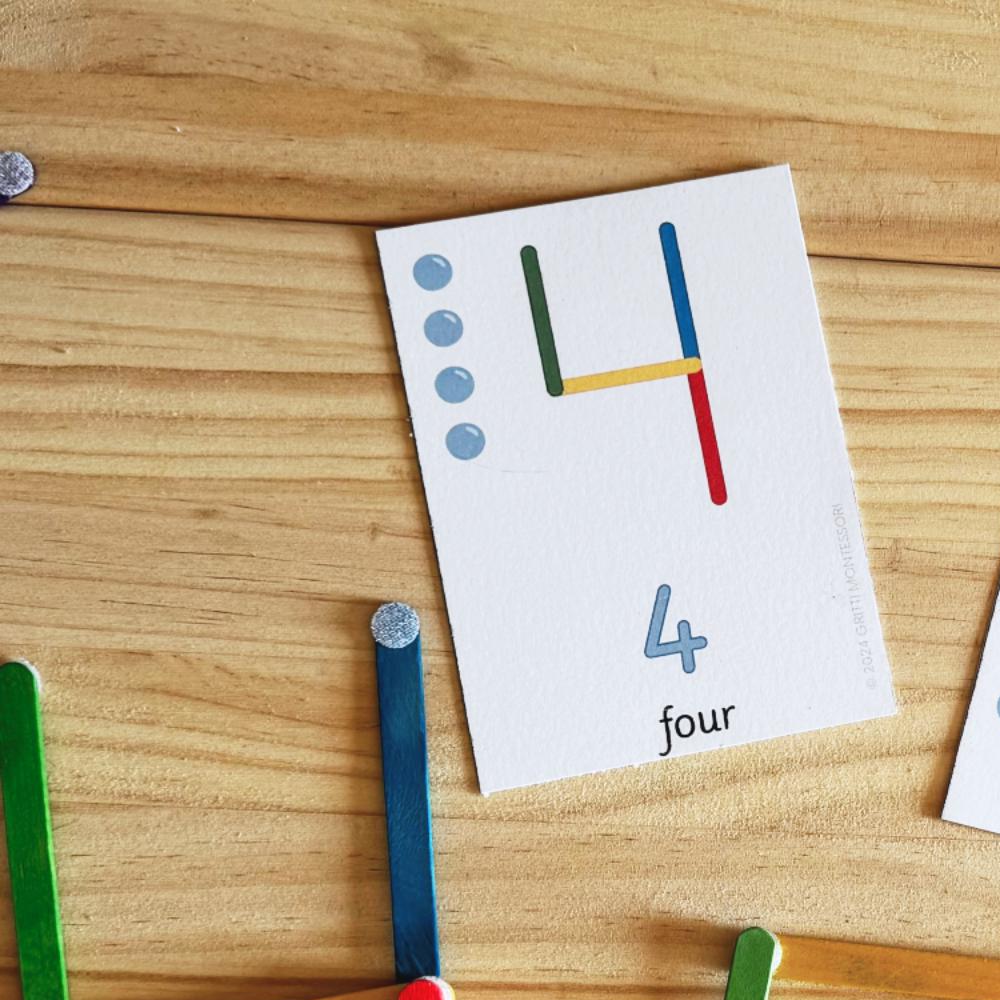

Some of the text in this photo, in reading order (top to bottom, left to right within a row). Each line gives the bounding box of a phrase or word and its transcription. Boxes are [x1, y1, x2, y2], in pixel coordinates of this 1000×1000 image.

[832, 503, 859, 592] MONTESSORI
[644, 584, 708, 674] 4
[849, 594, 868, 637] GRITTI
[858, 640, 876, 674] 2024
[658, 704, 736, 757] four
